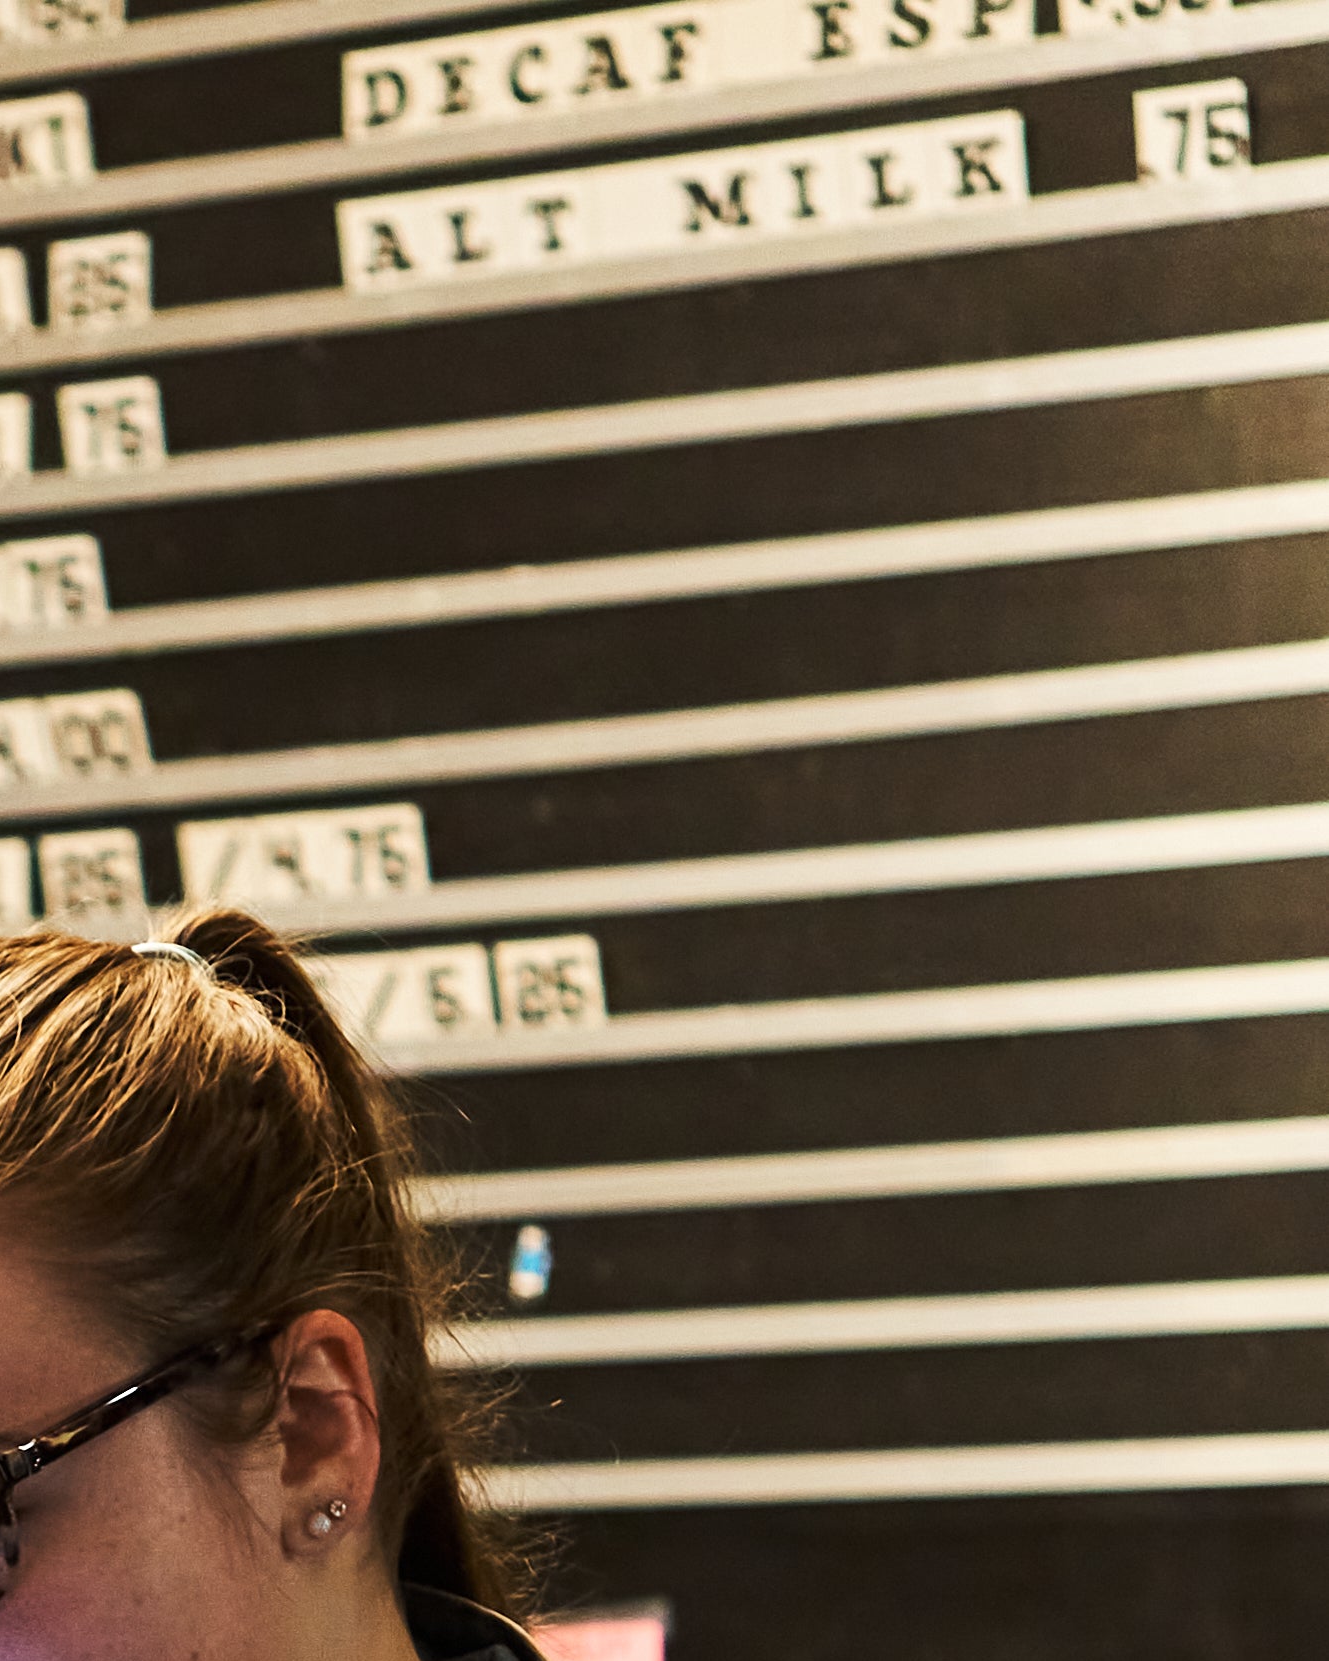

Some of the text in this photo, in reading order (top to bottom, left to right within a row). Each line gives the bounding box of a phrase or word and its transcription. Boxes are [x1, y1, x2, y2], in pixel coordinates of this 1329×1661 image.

[364, 20, 698, 128] DECAF
[365, 198, 573, 275] ALT
[682, 138, 1002, 233] MILK
